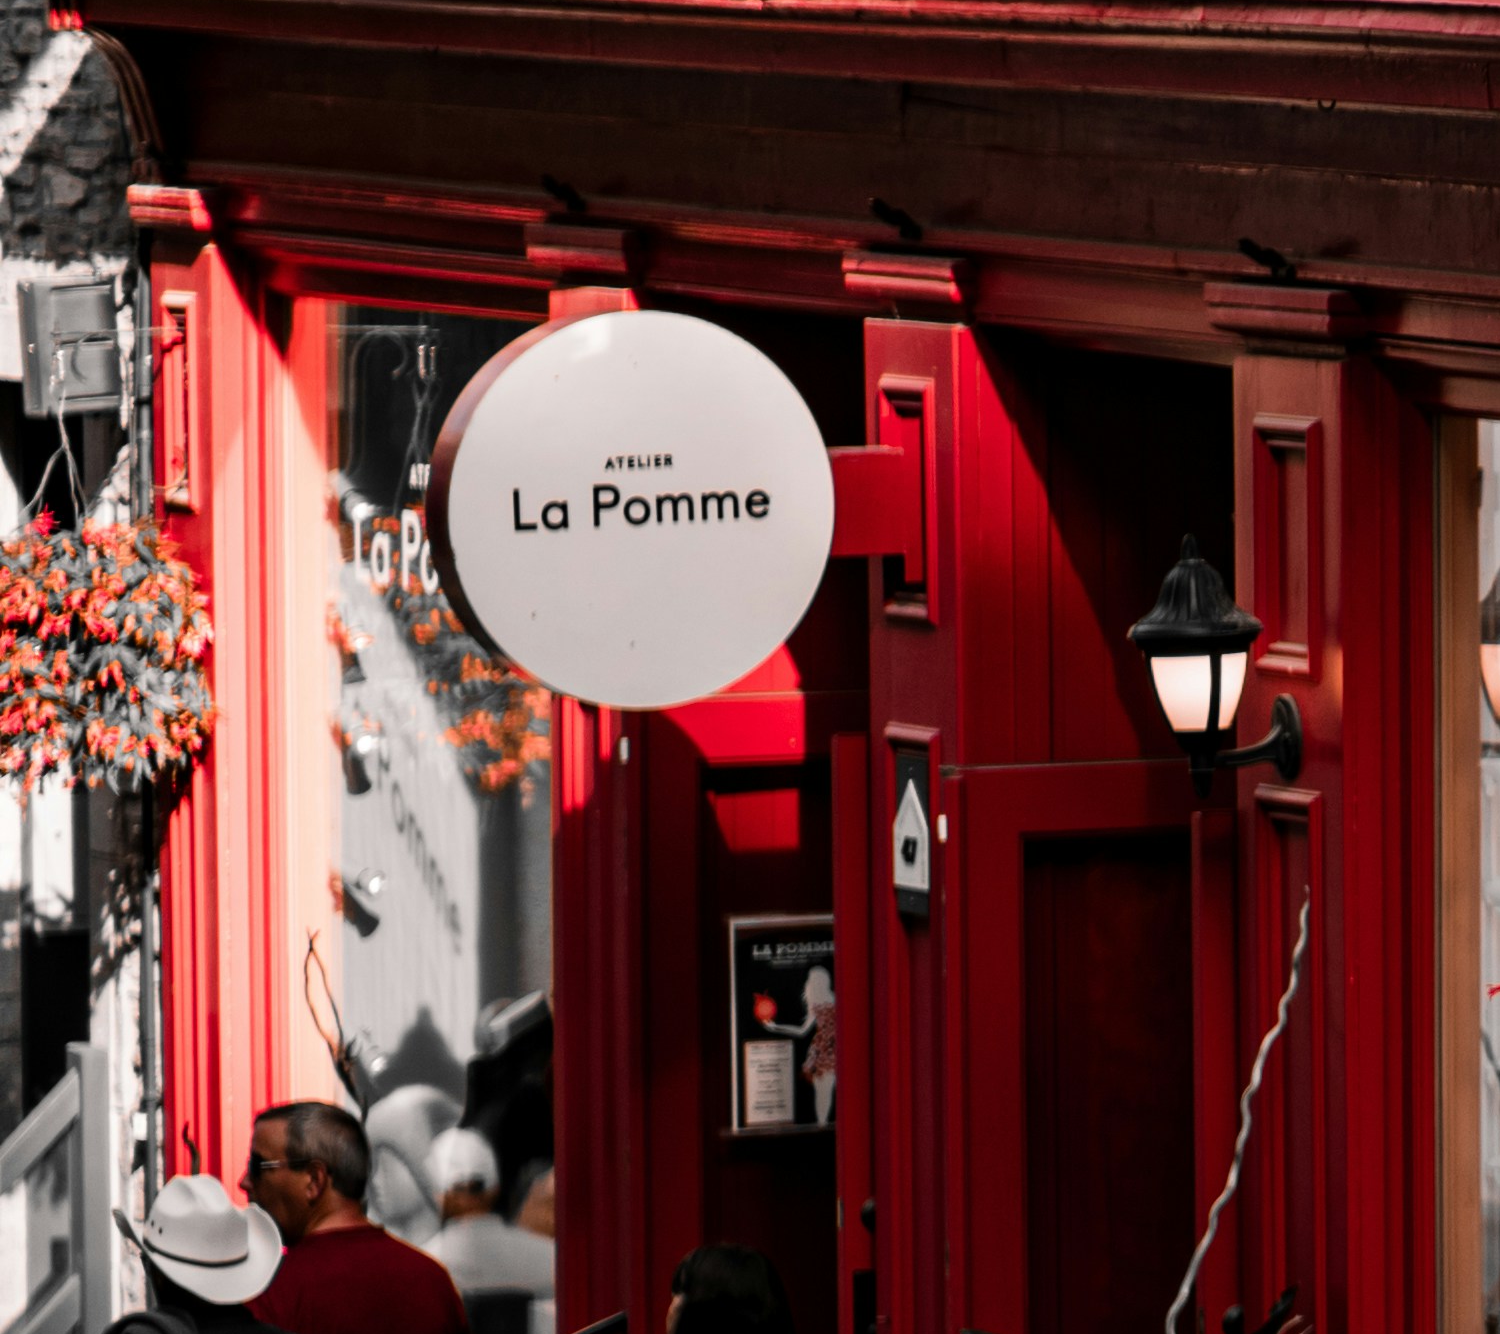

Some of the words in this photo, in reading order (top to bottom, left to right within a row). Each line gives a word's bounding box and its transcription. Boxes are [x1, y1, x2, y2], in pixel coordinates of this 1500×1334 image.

[605, 453, 674, 470] ATELIER
[512, 488, 569, 531] La
[593, 484, 770, 528] Pomme
